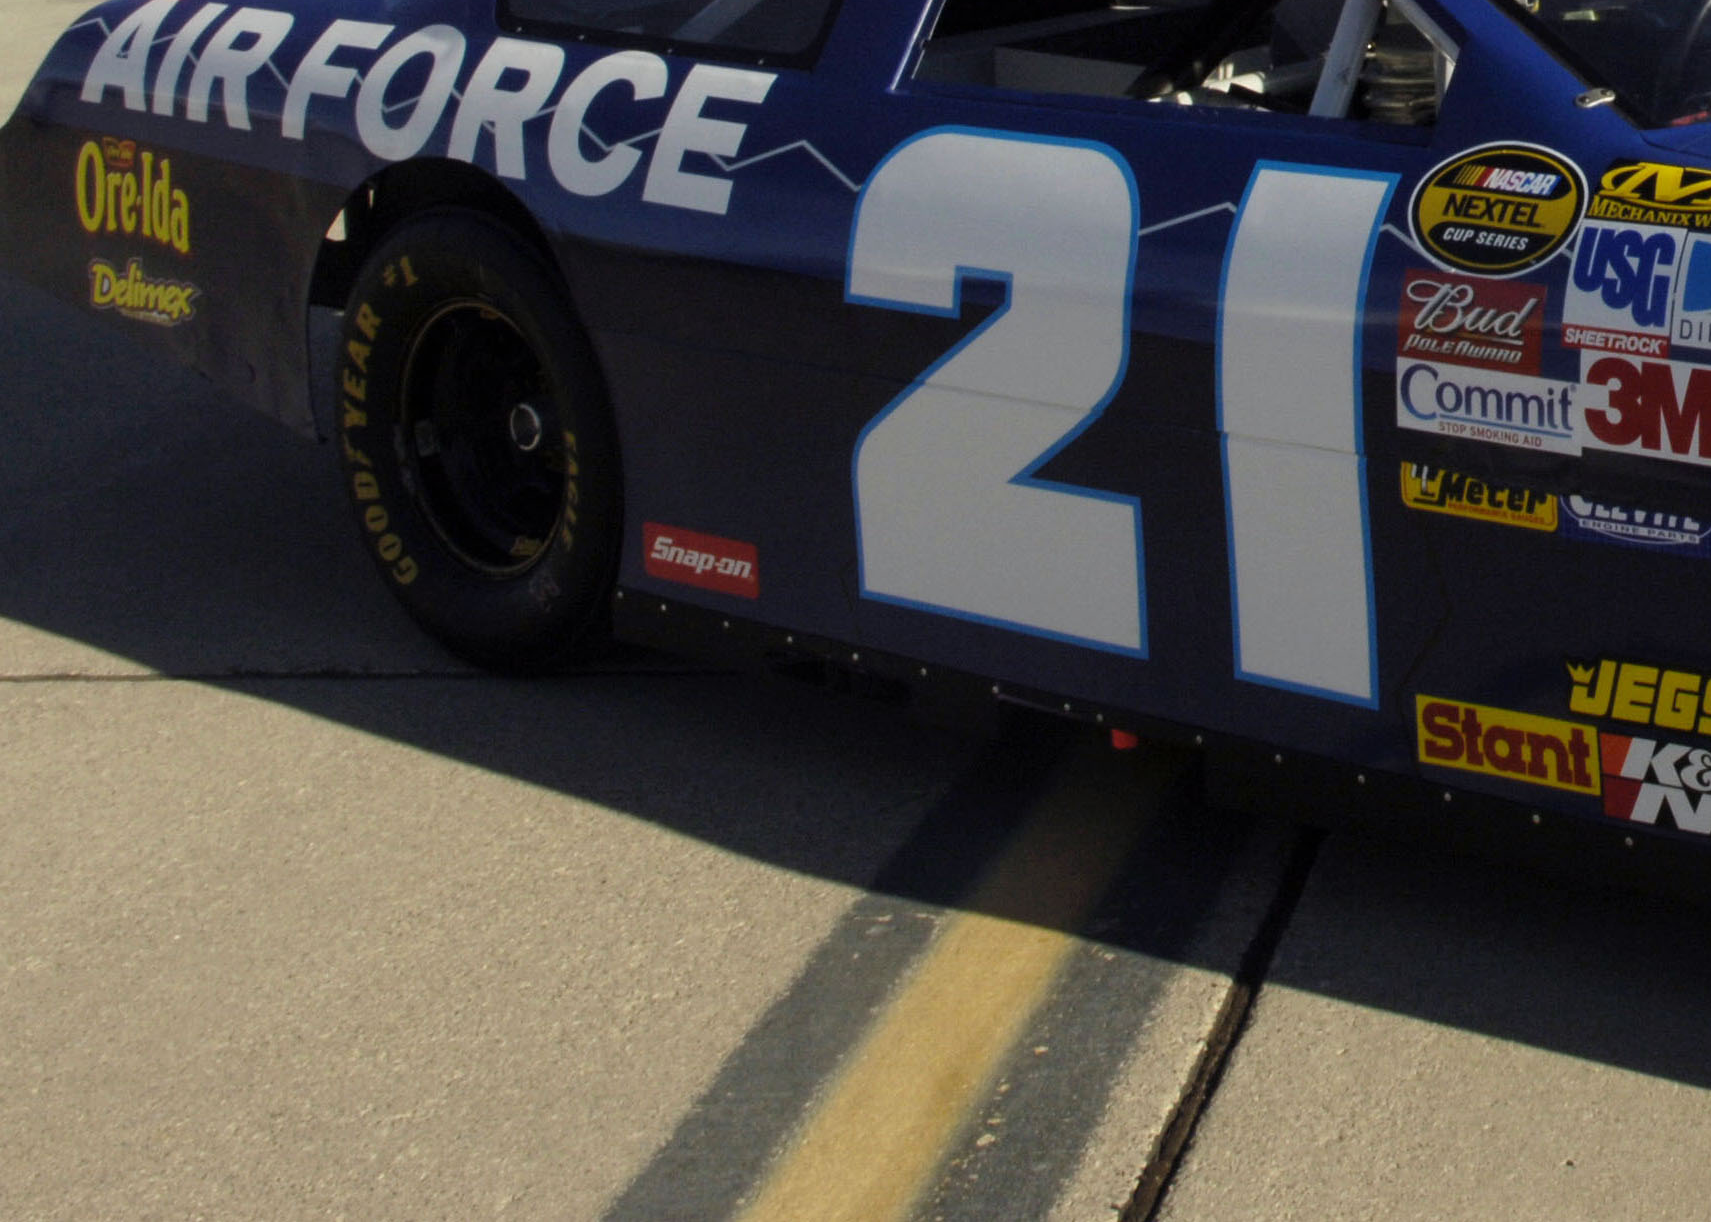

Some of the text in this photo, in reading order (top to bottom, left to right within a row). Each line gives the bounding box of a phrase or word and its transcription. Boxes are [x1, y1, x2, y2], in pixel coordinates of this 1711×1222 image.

[281, 19, 779, 216] FORCE
[1484, 165, 1560, 196] NASCAR
[1443, 193, 1542, 229] NEXTEL
[1443, 227, 1528, 252] CUP SERIES
[1590, 194, 1690, 227] MECHANIX
[90, 261, 195, 320] Delimex
[1572, 227, 1675, 329] USG
[1405, 279, 1538, 339] Bud
[1564, 327, 1666, 356] SHEETROCK
[845, 124, 1402, 710] 21
[1400, 363, 1574, 430] Commit
[342, 301, 419, 586] GOODYEAR
[1438, 421, 1542, 448] STOP SMOKING AID
[649, 535, 754, 581] Snap-on
[1422, 701, 1593, 789] Stant
